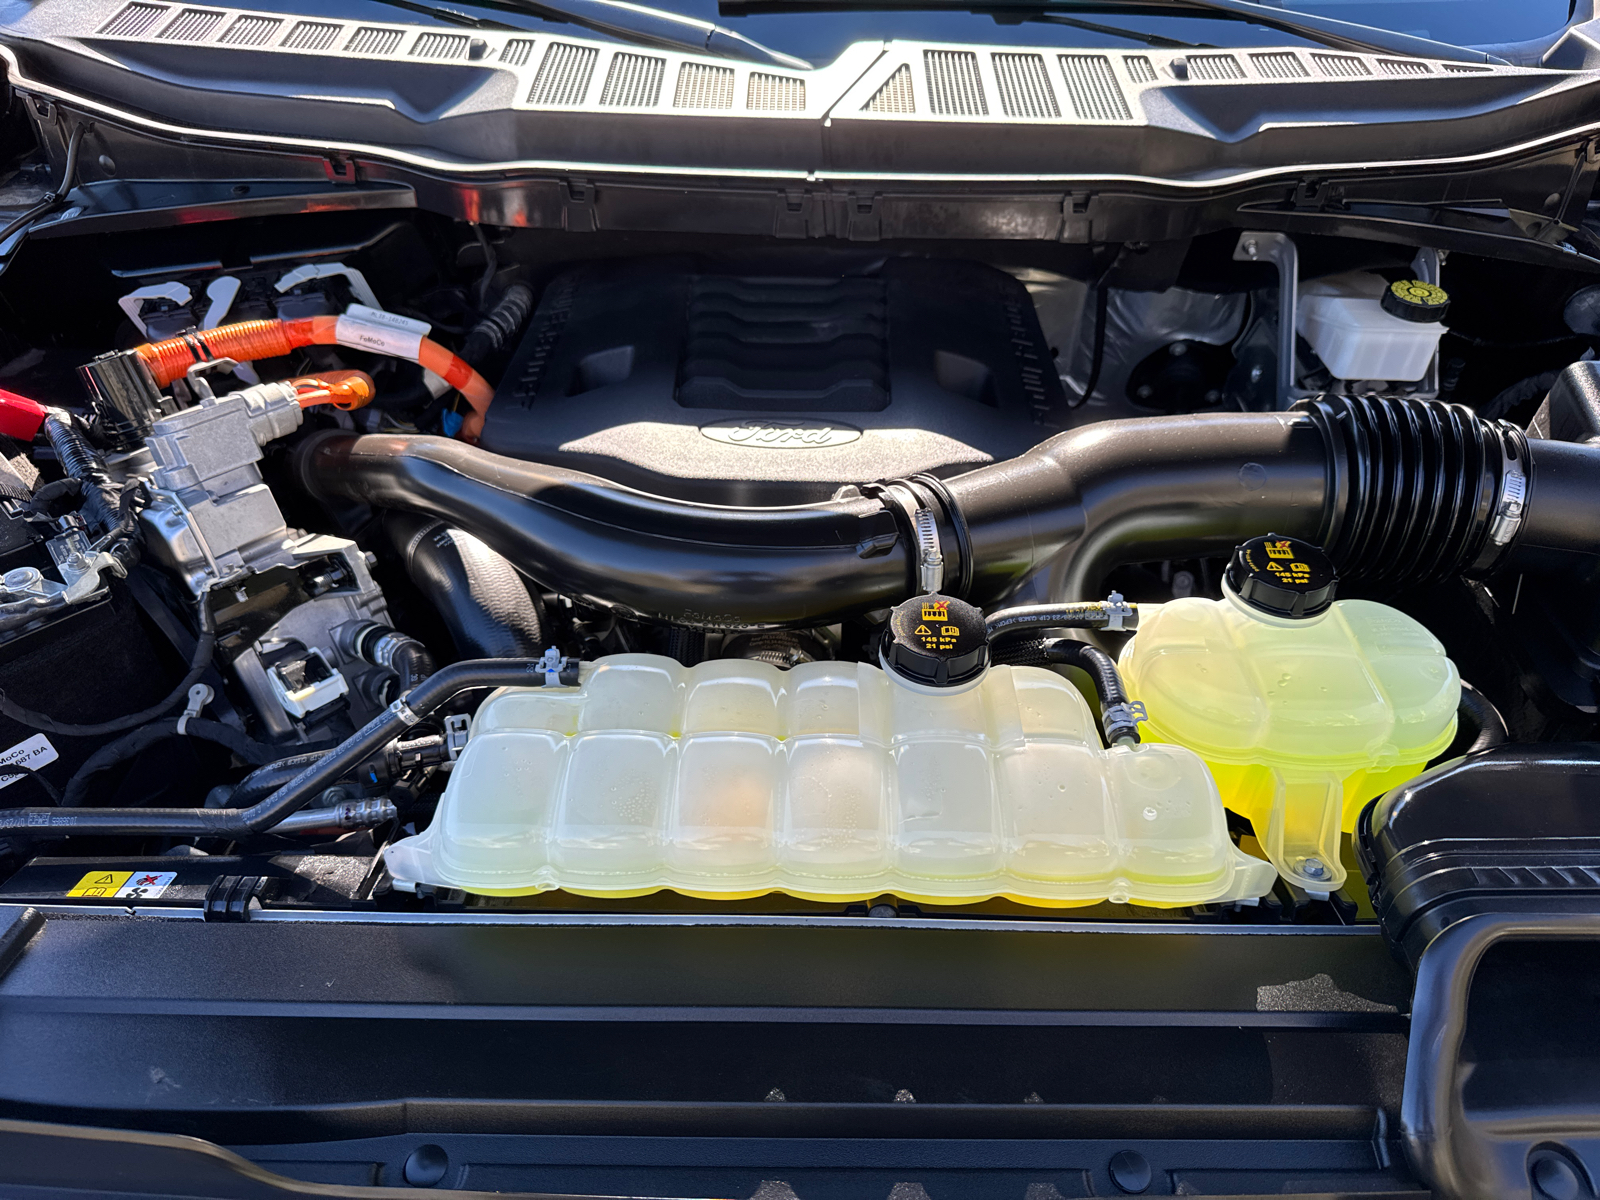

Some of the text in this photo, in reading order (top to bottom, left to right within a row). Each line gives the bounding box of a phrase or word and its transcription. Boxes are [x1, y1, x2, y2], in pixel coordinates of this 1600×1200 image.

[359, 334, 386, 347] FoMoCo
[728, 419, 835, 444] Ford
[33, 746, 48, 756] BA
